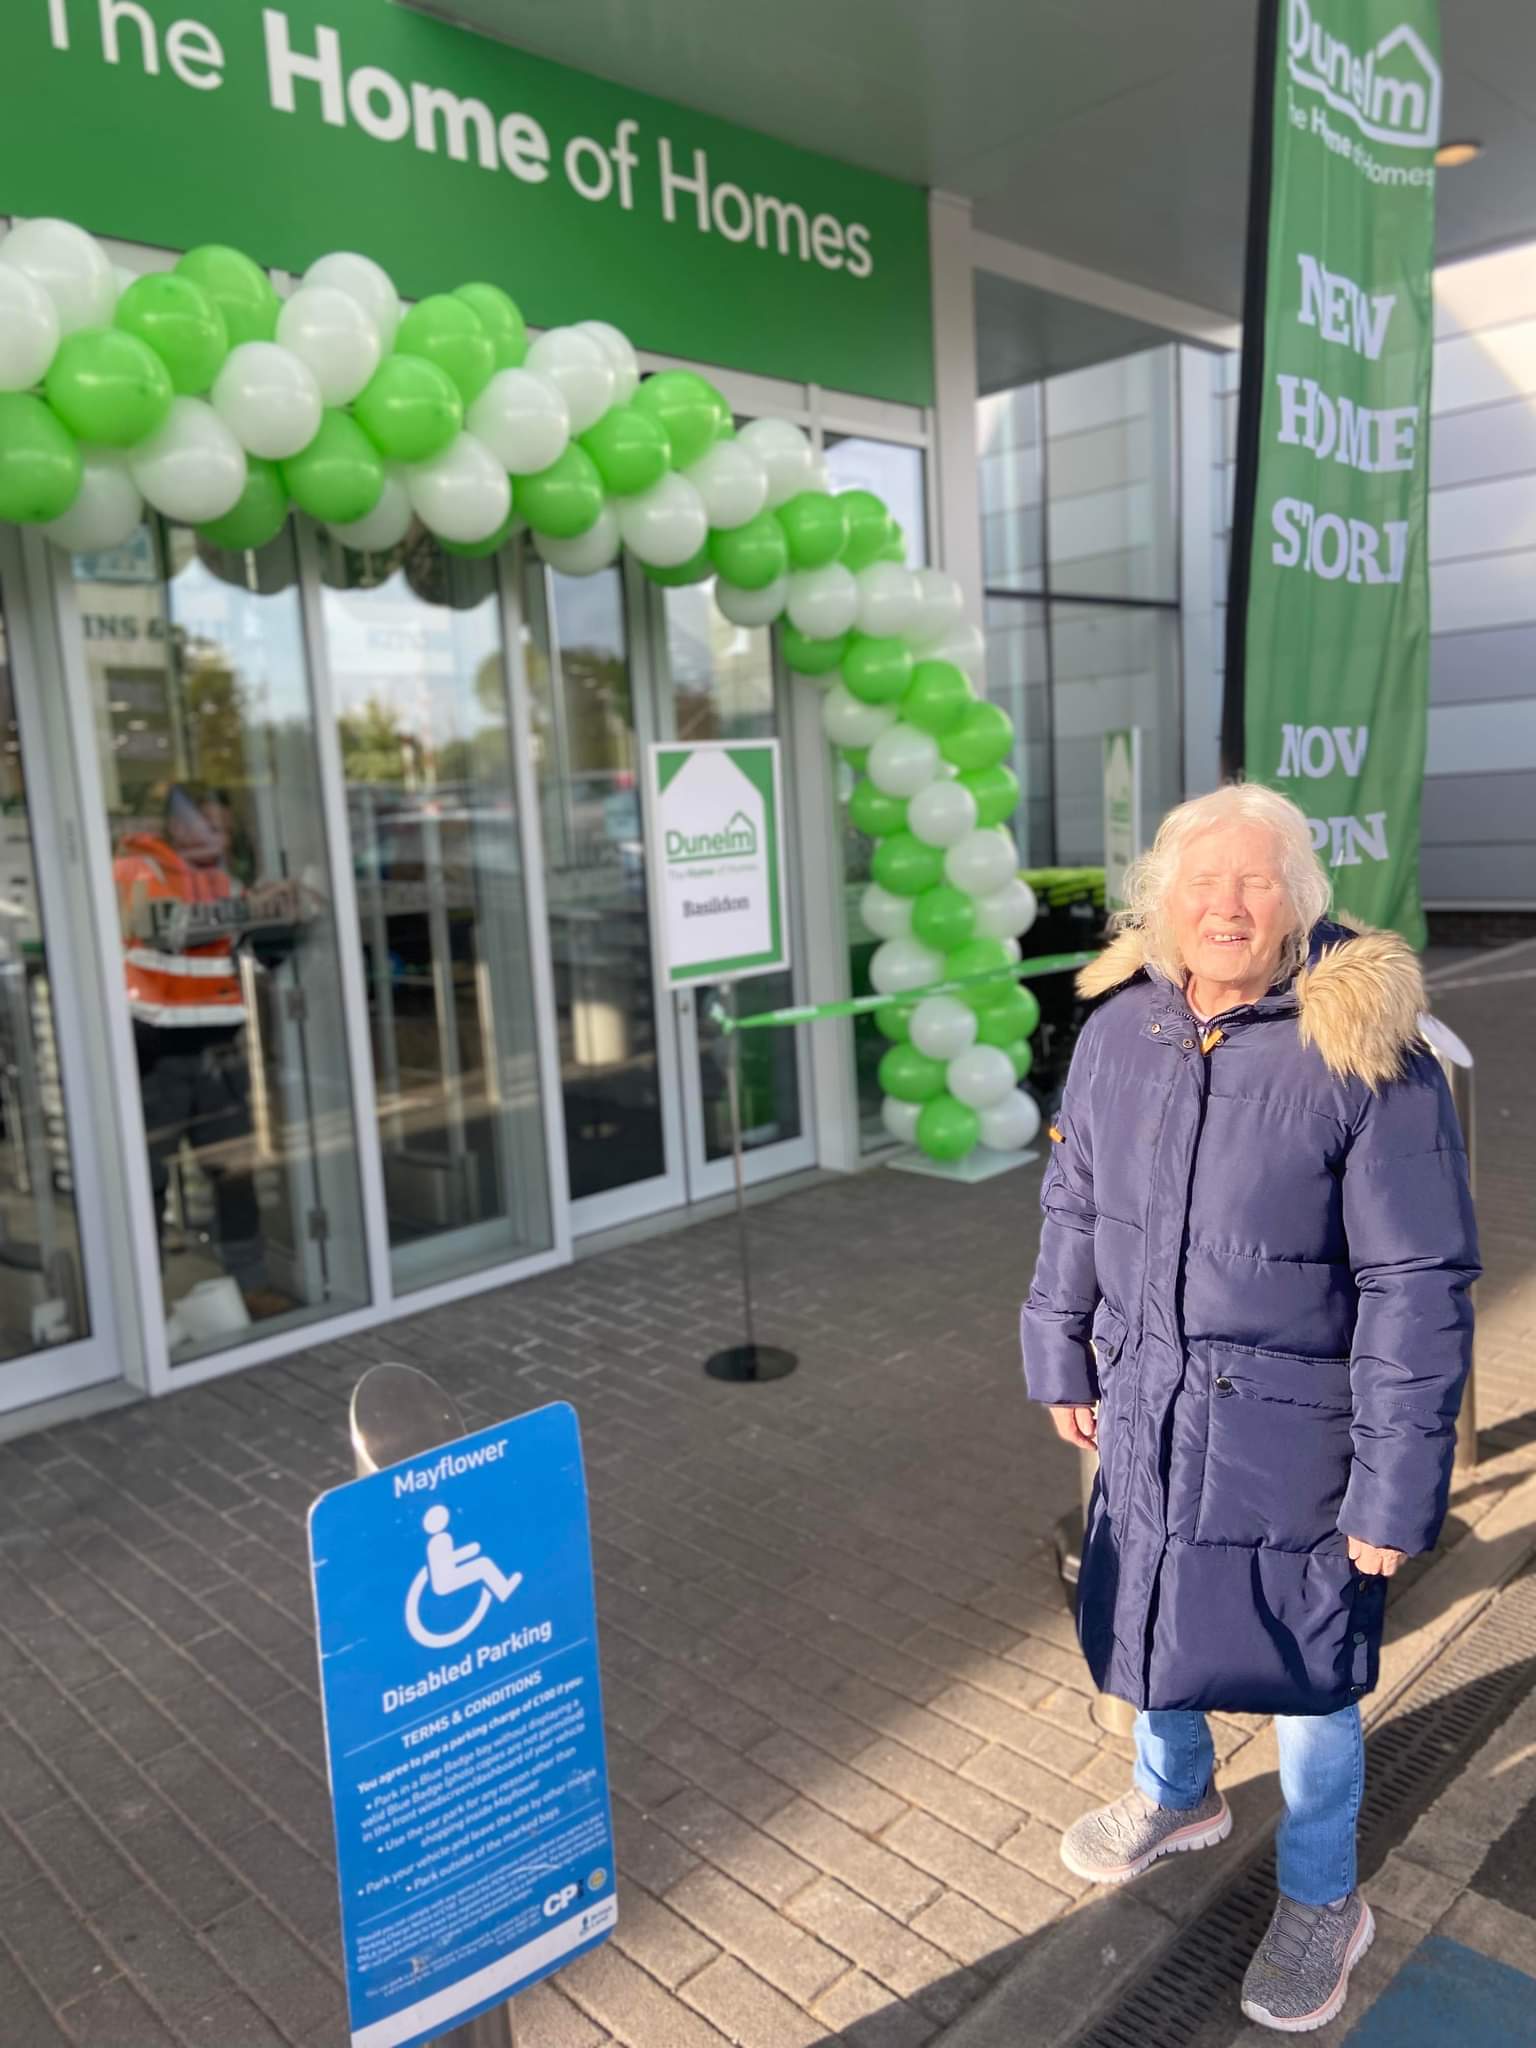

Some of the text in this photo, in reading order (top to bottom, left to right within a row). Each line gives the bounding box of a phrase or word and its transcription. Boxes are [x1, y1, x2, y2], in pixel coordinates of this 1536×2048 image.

[263, 8, 551, 183] Home
[564, 119, 640, 211] of
[657, 137, 874, 278] Homes
[1297, 252, 1397, 361] NEW
[1276, 373, 1420, 474] HOME
[665, 826, 752, 856] Dunelm
[682, 894, 751, 918] Basildon
[394, 1439, 508, 1499] Mayflower
[382, 1621, 553, 1714] Disabled Parking
[401, 1669, 541, 1749] TERMS & CONDITIONS
[358, 1776, 377, 1794] You
[378, 1762, 408, 1785] agree
[410, 1756, 421, 1768] to
[422, 1746, 441, 1764] pay
[449, 1722, 488, 1750] parking
[488, 1706, 520, 1731] charge
[522, 1700, 531, 1712] of
